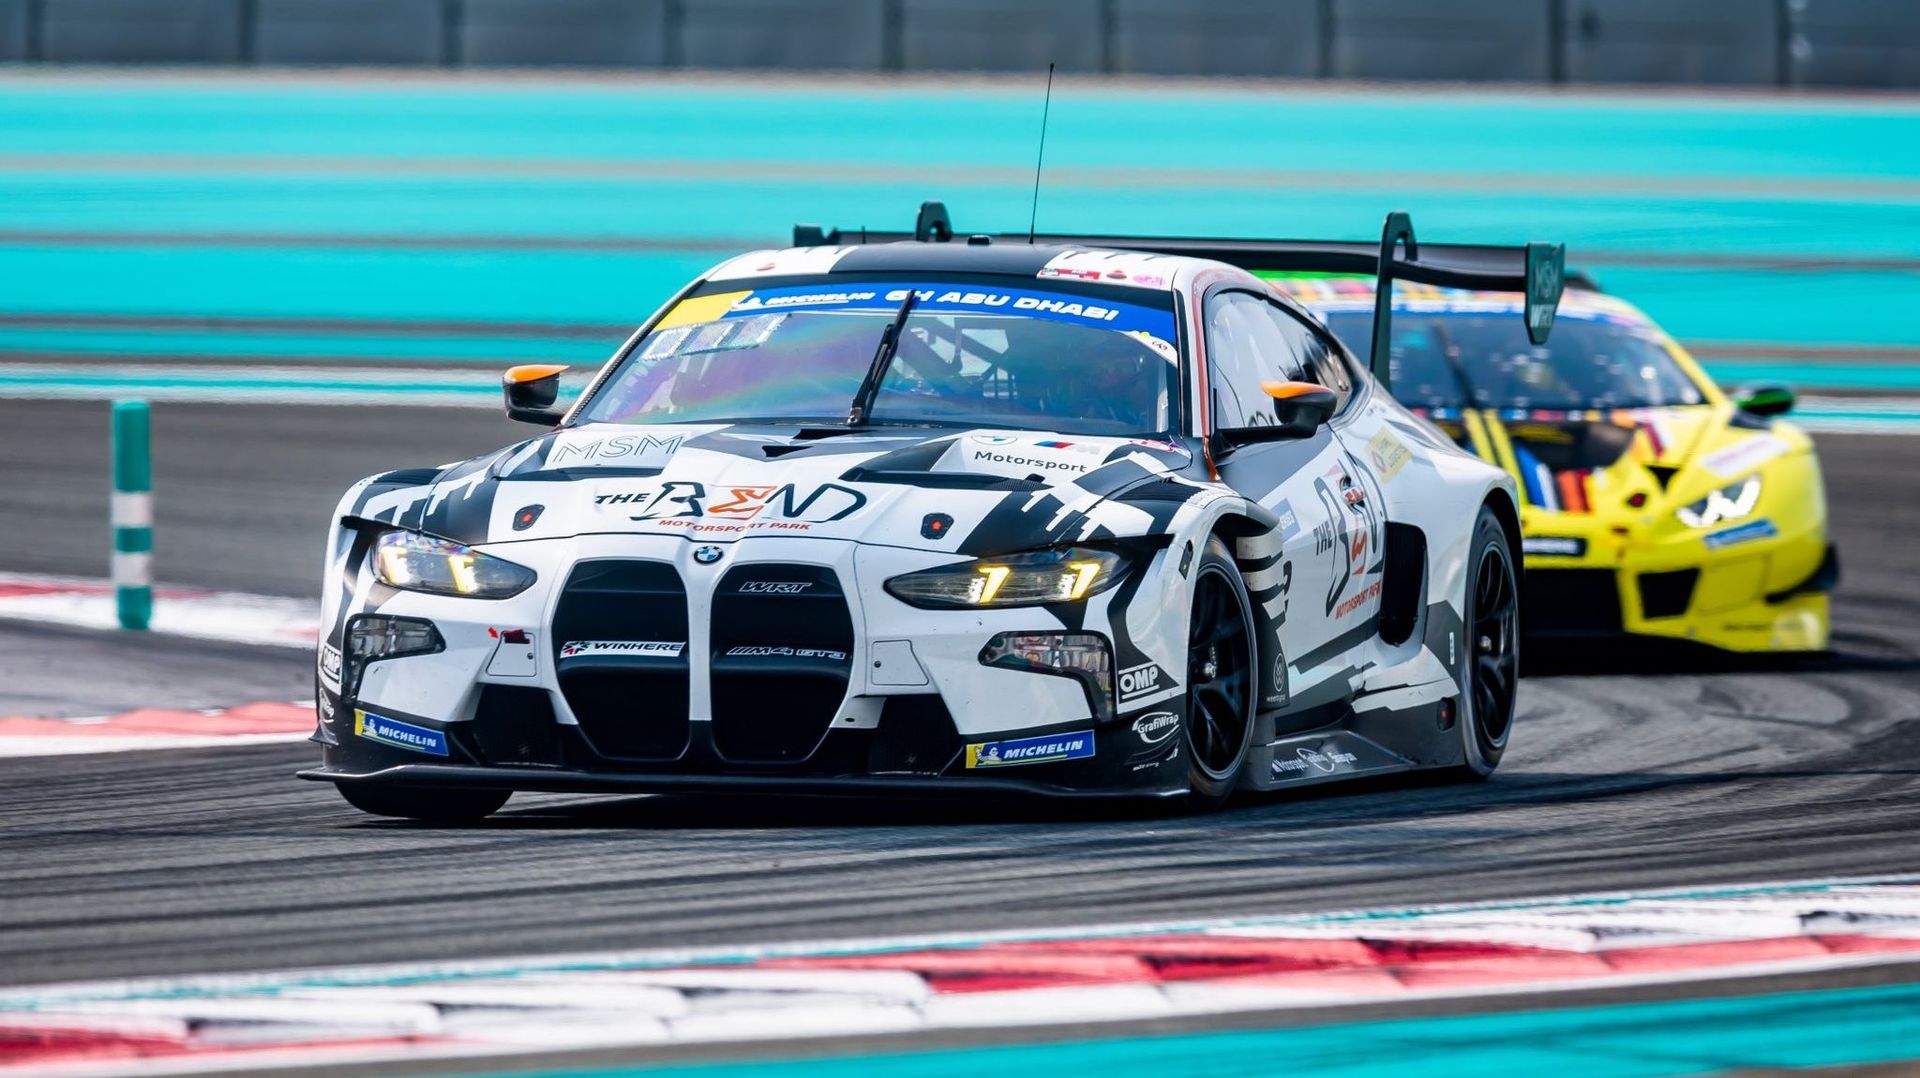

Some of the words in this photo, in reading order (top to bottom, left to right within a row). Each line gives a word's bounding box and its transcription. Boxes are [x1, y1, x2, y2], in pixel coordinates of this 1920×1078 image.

[936, 291, 1010, 306] ABU
[1013, 296, 1120, 321] DHABI
[553, 433, 686, 463] MSM
[974, 451, 1088, 472] Motorsport
[595, 492, 651, 505] THE
[658, 519, 766, 533] MOTORSPORT
[768, 522, 812, 531] PARK
[1313, 520, 1333, 556] THE
[739, 581, 813, 593] WRT
[593, 641, 684, 651] WINHERE
[1120, 666, 1159, 692] OMP
[1137, 714, 1179, 733] GrafiWrap
[378, 725, 437, 748] MICHELIN
[1003, 740, 1084, 759] MICHELIN
